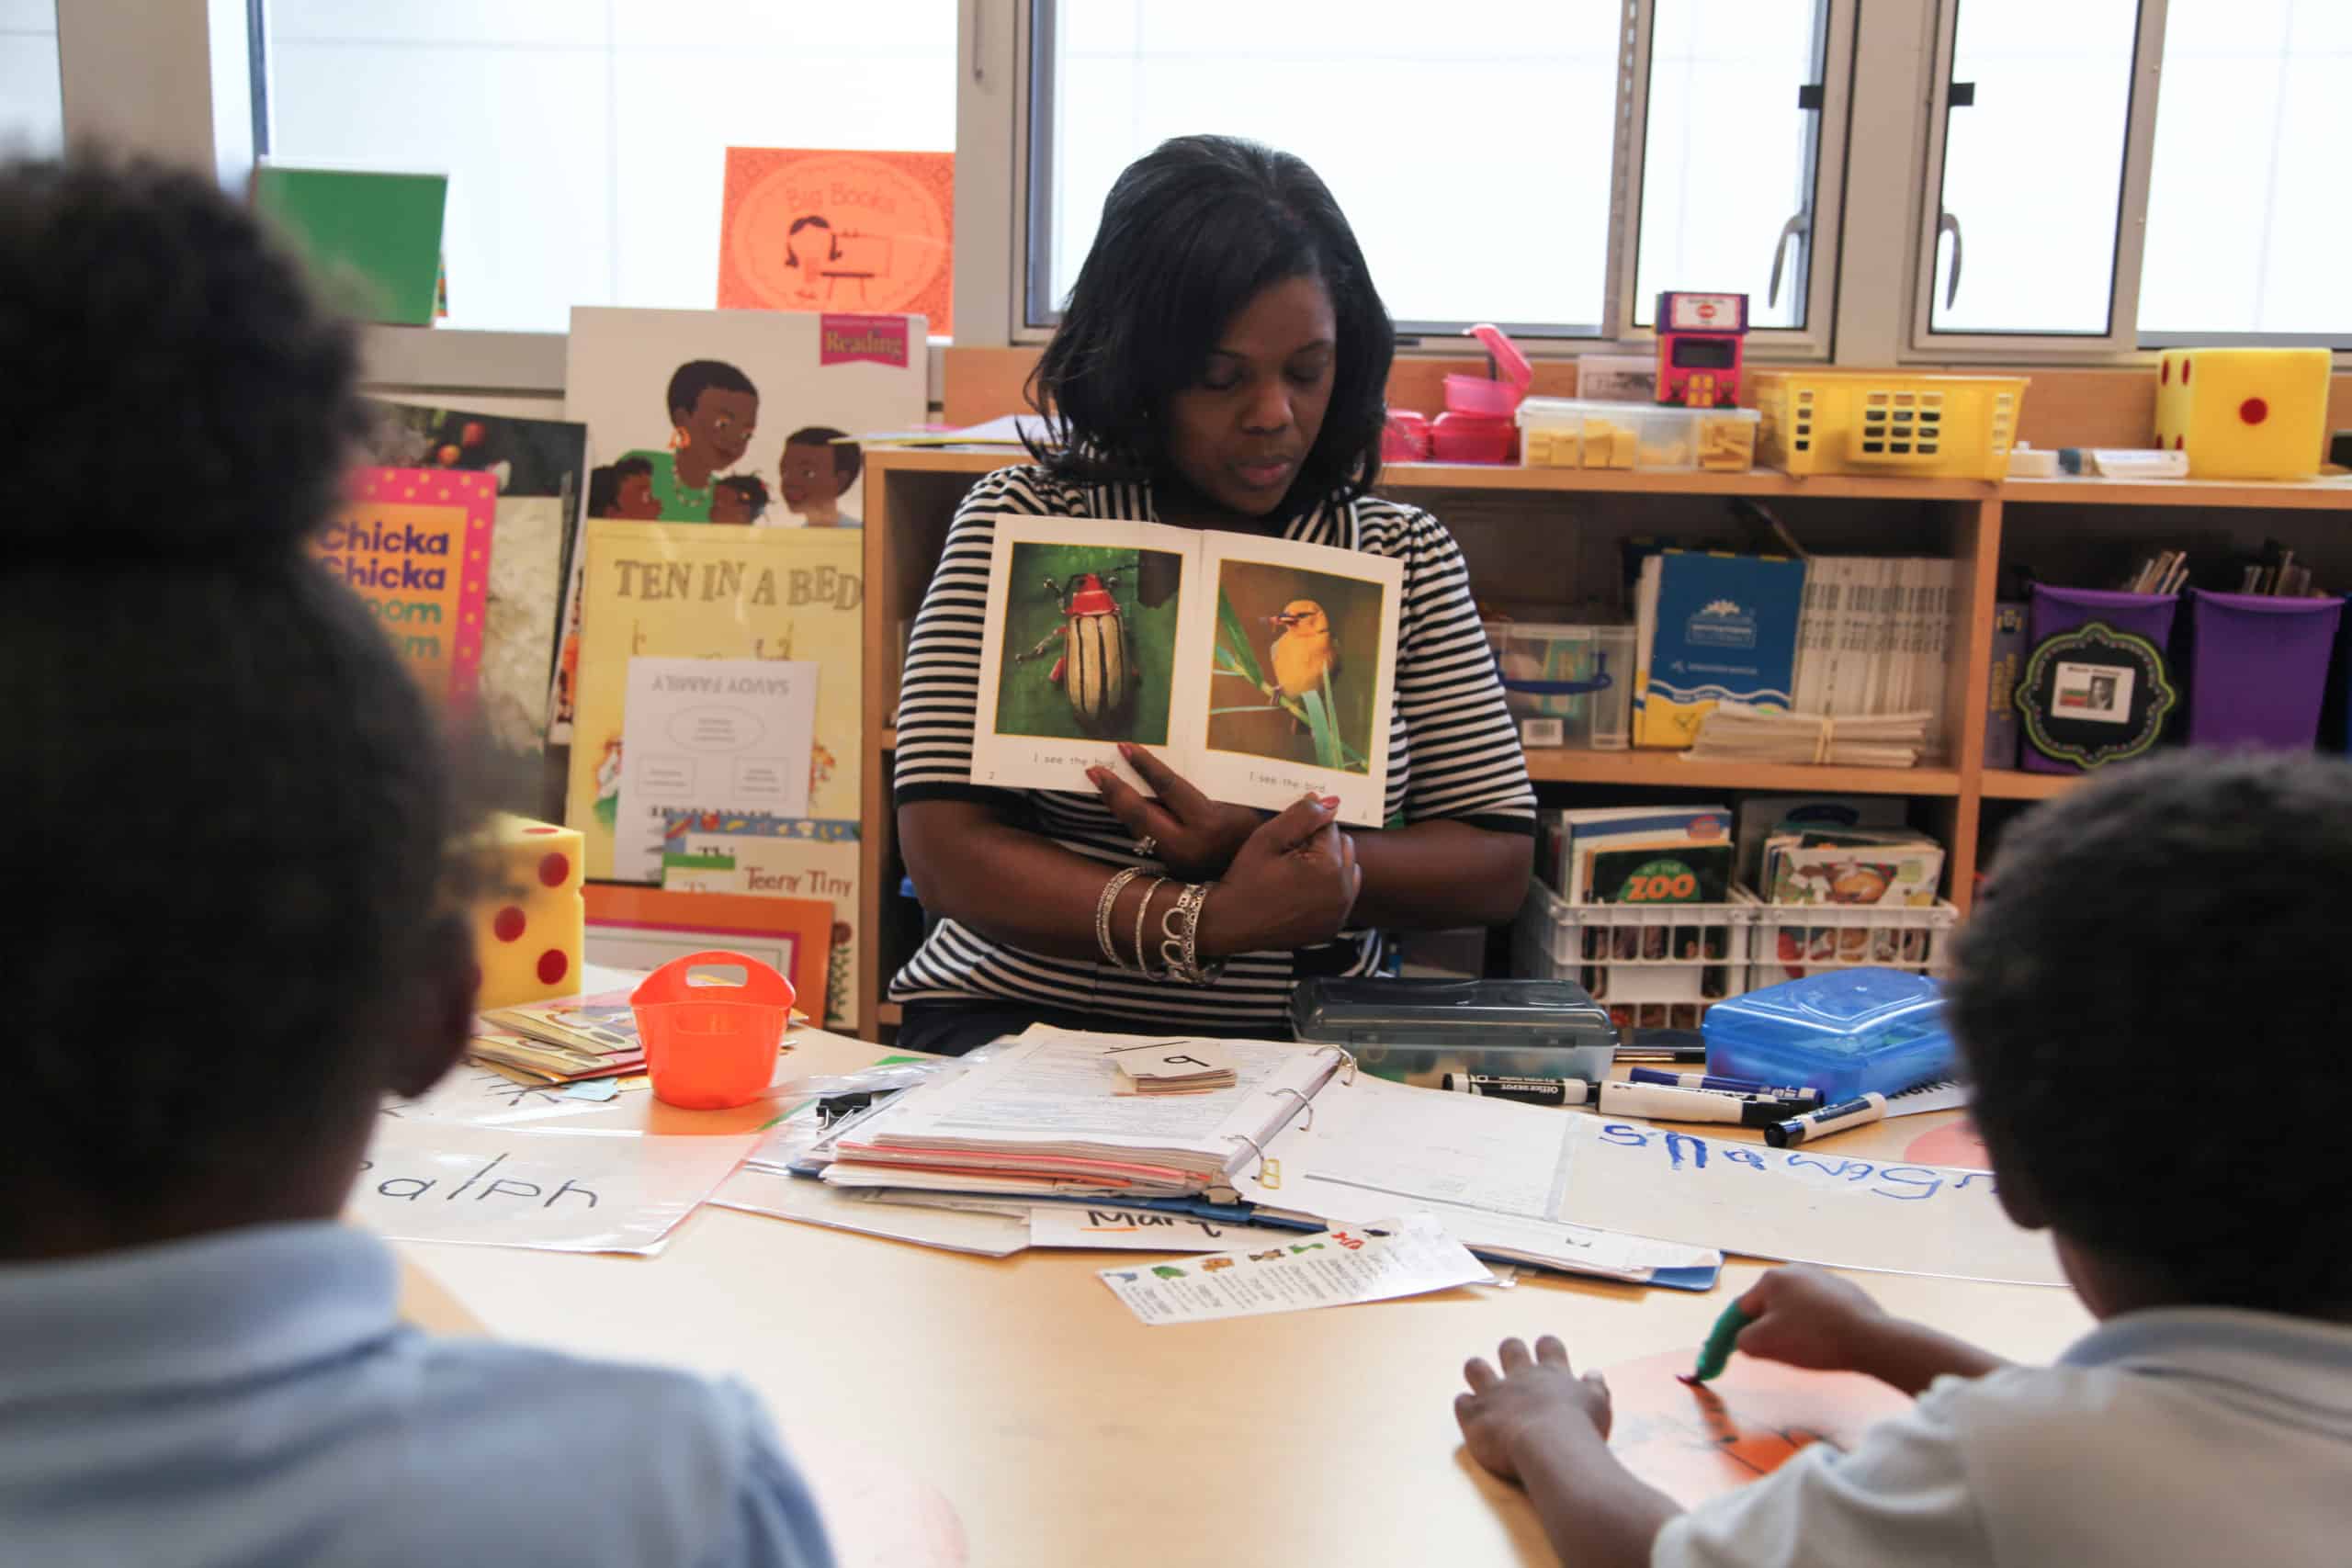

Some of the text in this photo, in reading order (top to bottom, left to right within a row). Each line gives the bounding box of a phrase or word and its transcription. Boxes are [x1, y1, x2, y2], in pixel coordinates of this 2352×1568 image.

[786, 182, 897, 212] Big Books
[823, 328, 904, 361] Reading
[318, 520, 449, 556] Chicka
[614, 558, 865, 611] TEN IN A BED
[651, 673, 722, 695] FAMILY
[1044, 755, 1063, 766] see
[1069, 753, 1089, 767] the
[1259, 774, 1277, 785] see
[1282, 776, 1299, 788] the
[743, 866, 854, 897] Teeny Tiny
[1627, 873, 1696, 901] ZOO
[1530, 1085, 1559, 1095] Office
[359, 1152, 598, 1209] alph
